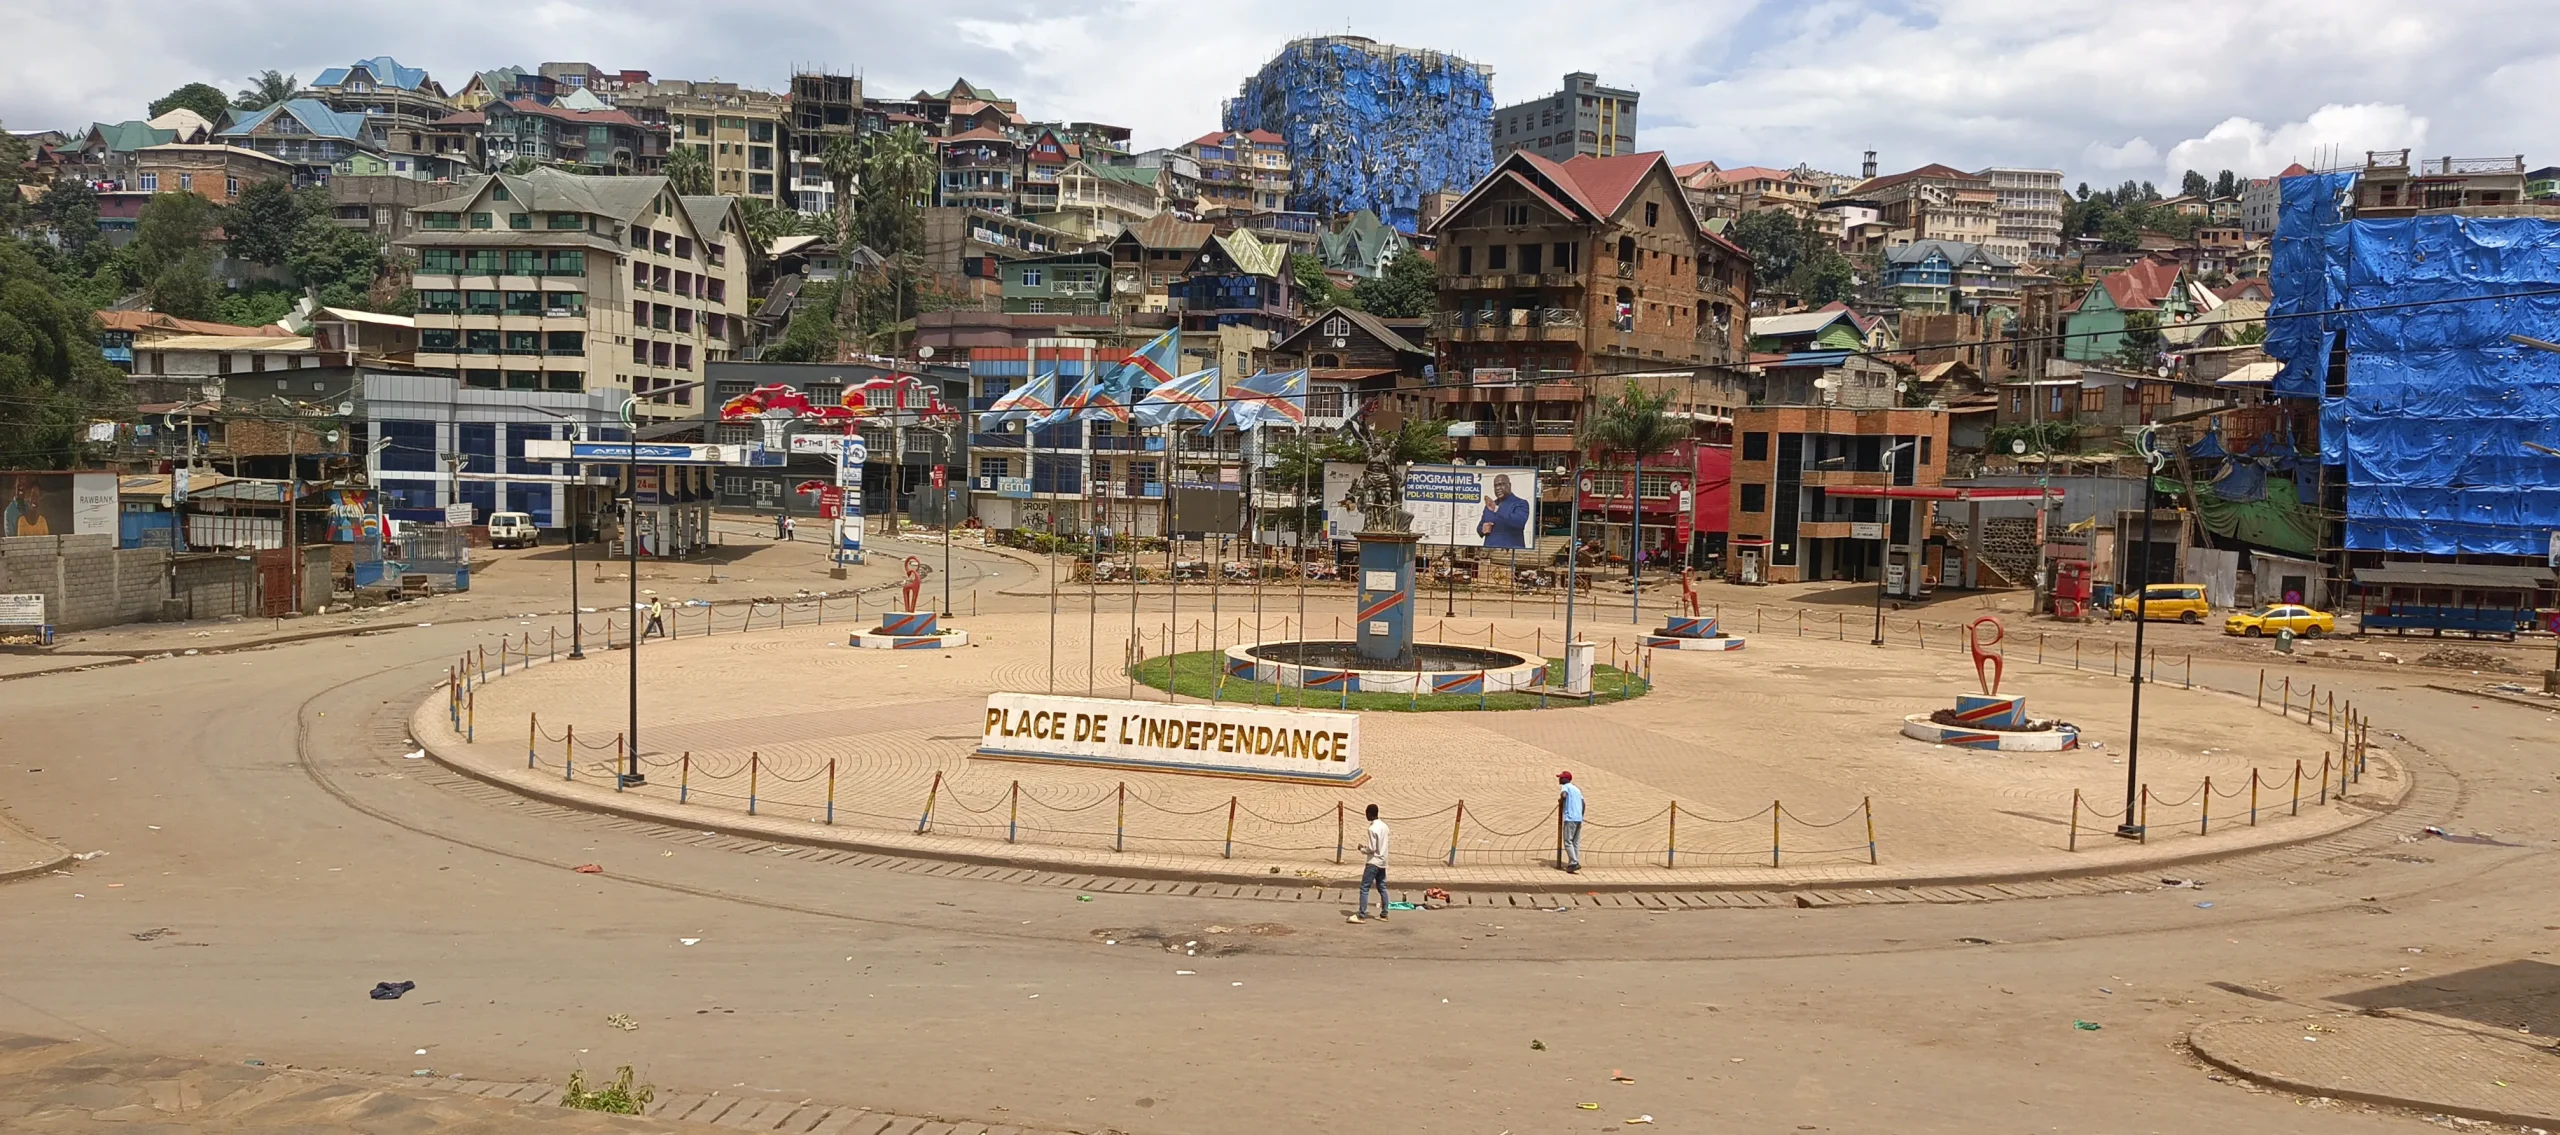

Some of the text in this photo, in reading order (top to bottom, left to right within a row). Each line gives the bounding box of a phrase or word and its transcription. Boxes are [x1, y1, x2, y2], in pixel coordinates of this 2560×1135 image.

[807, 439, 824, 447] TMB
[637, 479, 647, 489] 24
[1407, 473, 1473, 485] PROGRAMME
[998, 482, 1031, 492] TECNO
[79, 495, 114, 505] RAWBANK
[1406, 491, 1480, 501] PDL-145 TERRTOIRES
[1022, 502, 1049, 511] GROUP
[985, 707, 1067, 741] PLACE
[1074, 713, 1108, 743] DE
